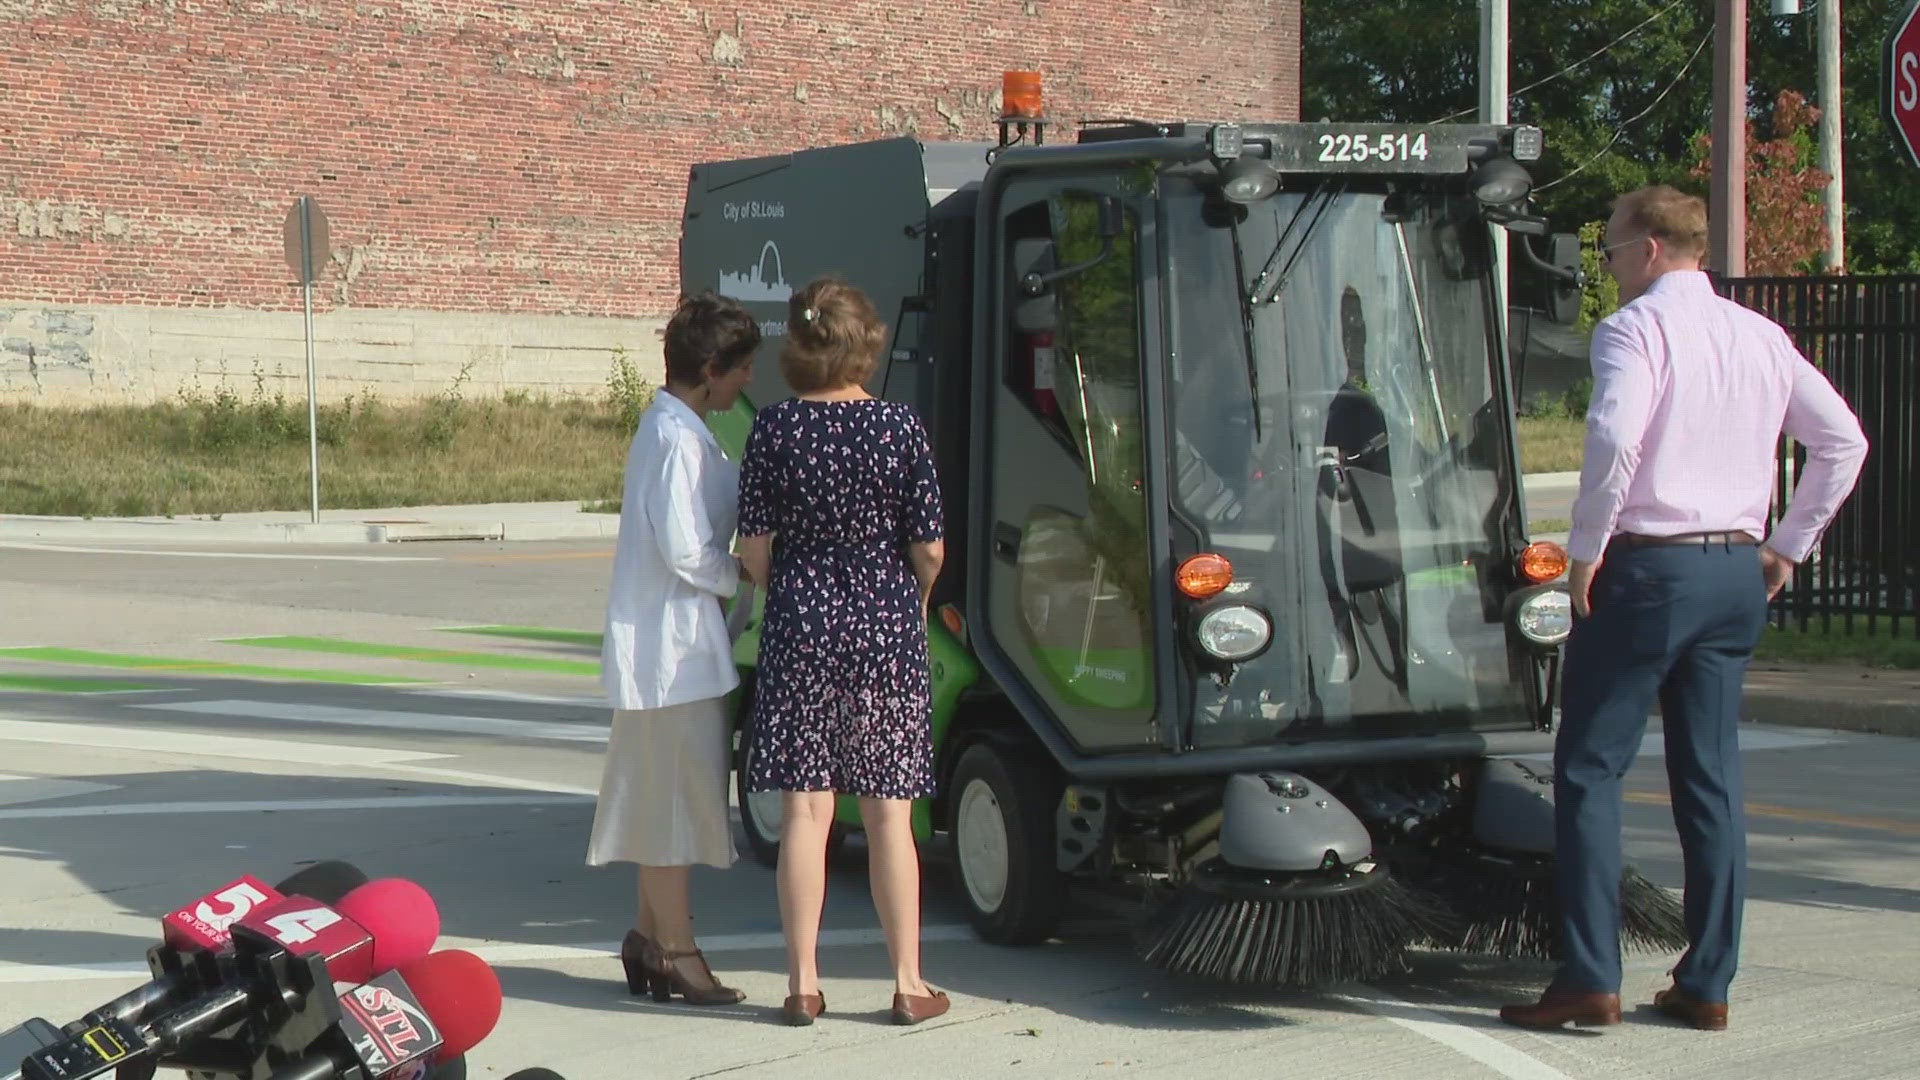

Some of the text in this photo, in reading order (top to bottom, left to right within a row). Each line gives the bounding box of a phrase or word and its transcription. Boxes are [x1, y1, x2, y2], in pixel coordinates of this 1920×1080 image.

[1318, 133, 1428, 162] 225-514
[723, 203, 740, 223] City
[741, 202, 750, 218] of
[195, 882, 269, 932] 5
[177, 911, 194, 924] ON
[191, 918, 216, 939] YOUR
[264, 906, 343, 945] 4
[359, 986, 422, 1057] STL
